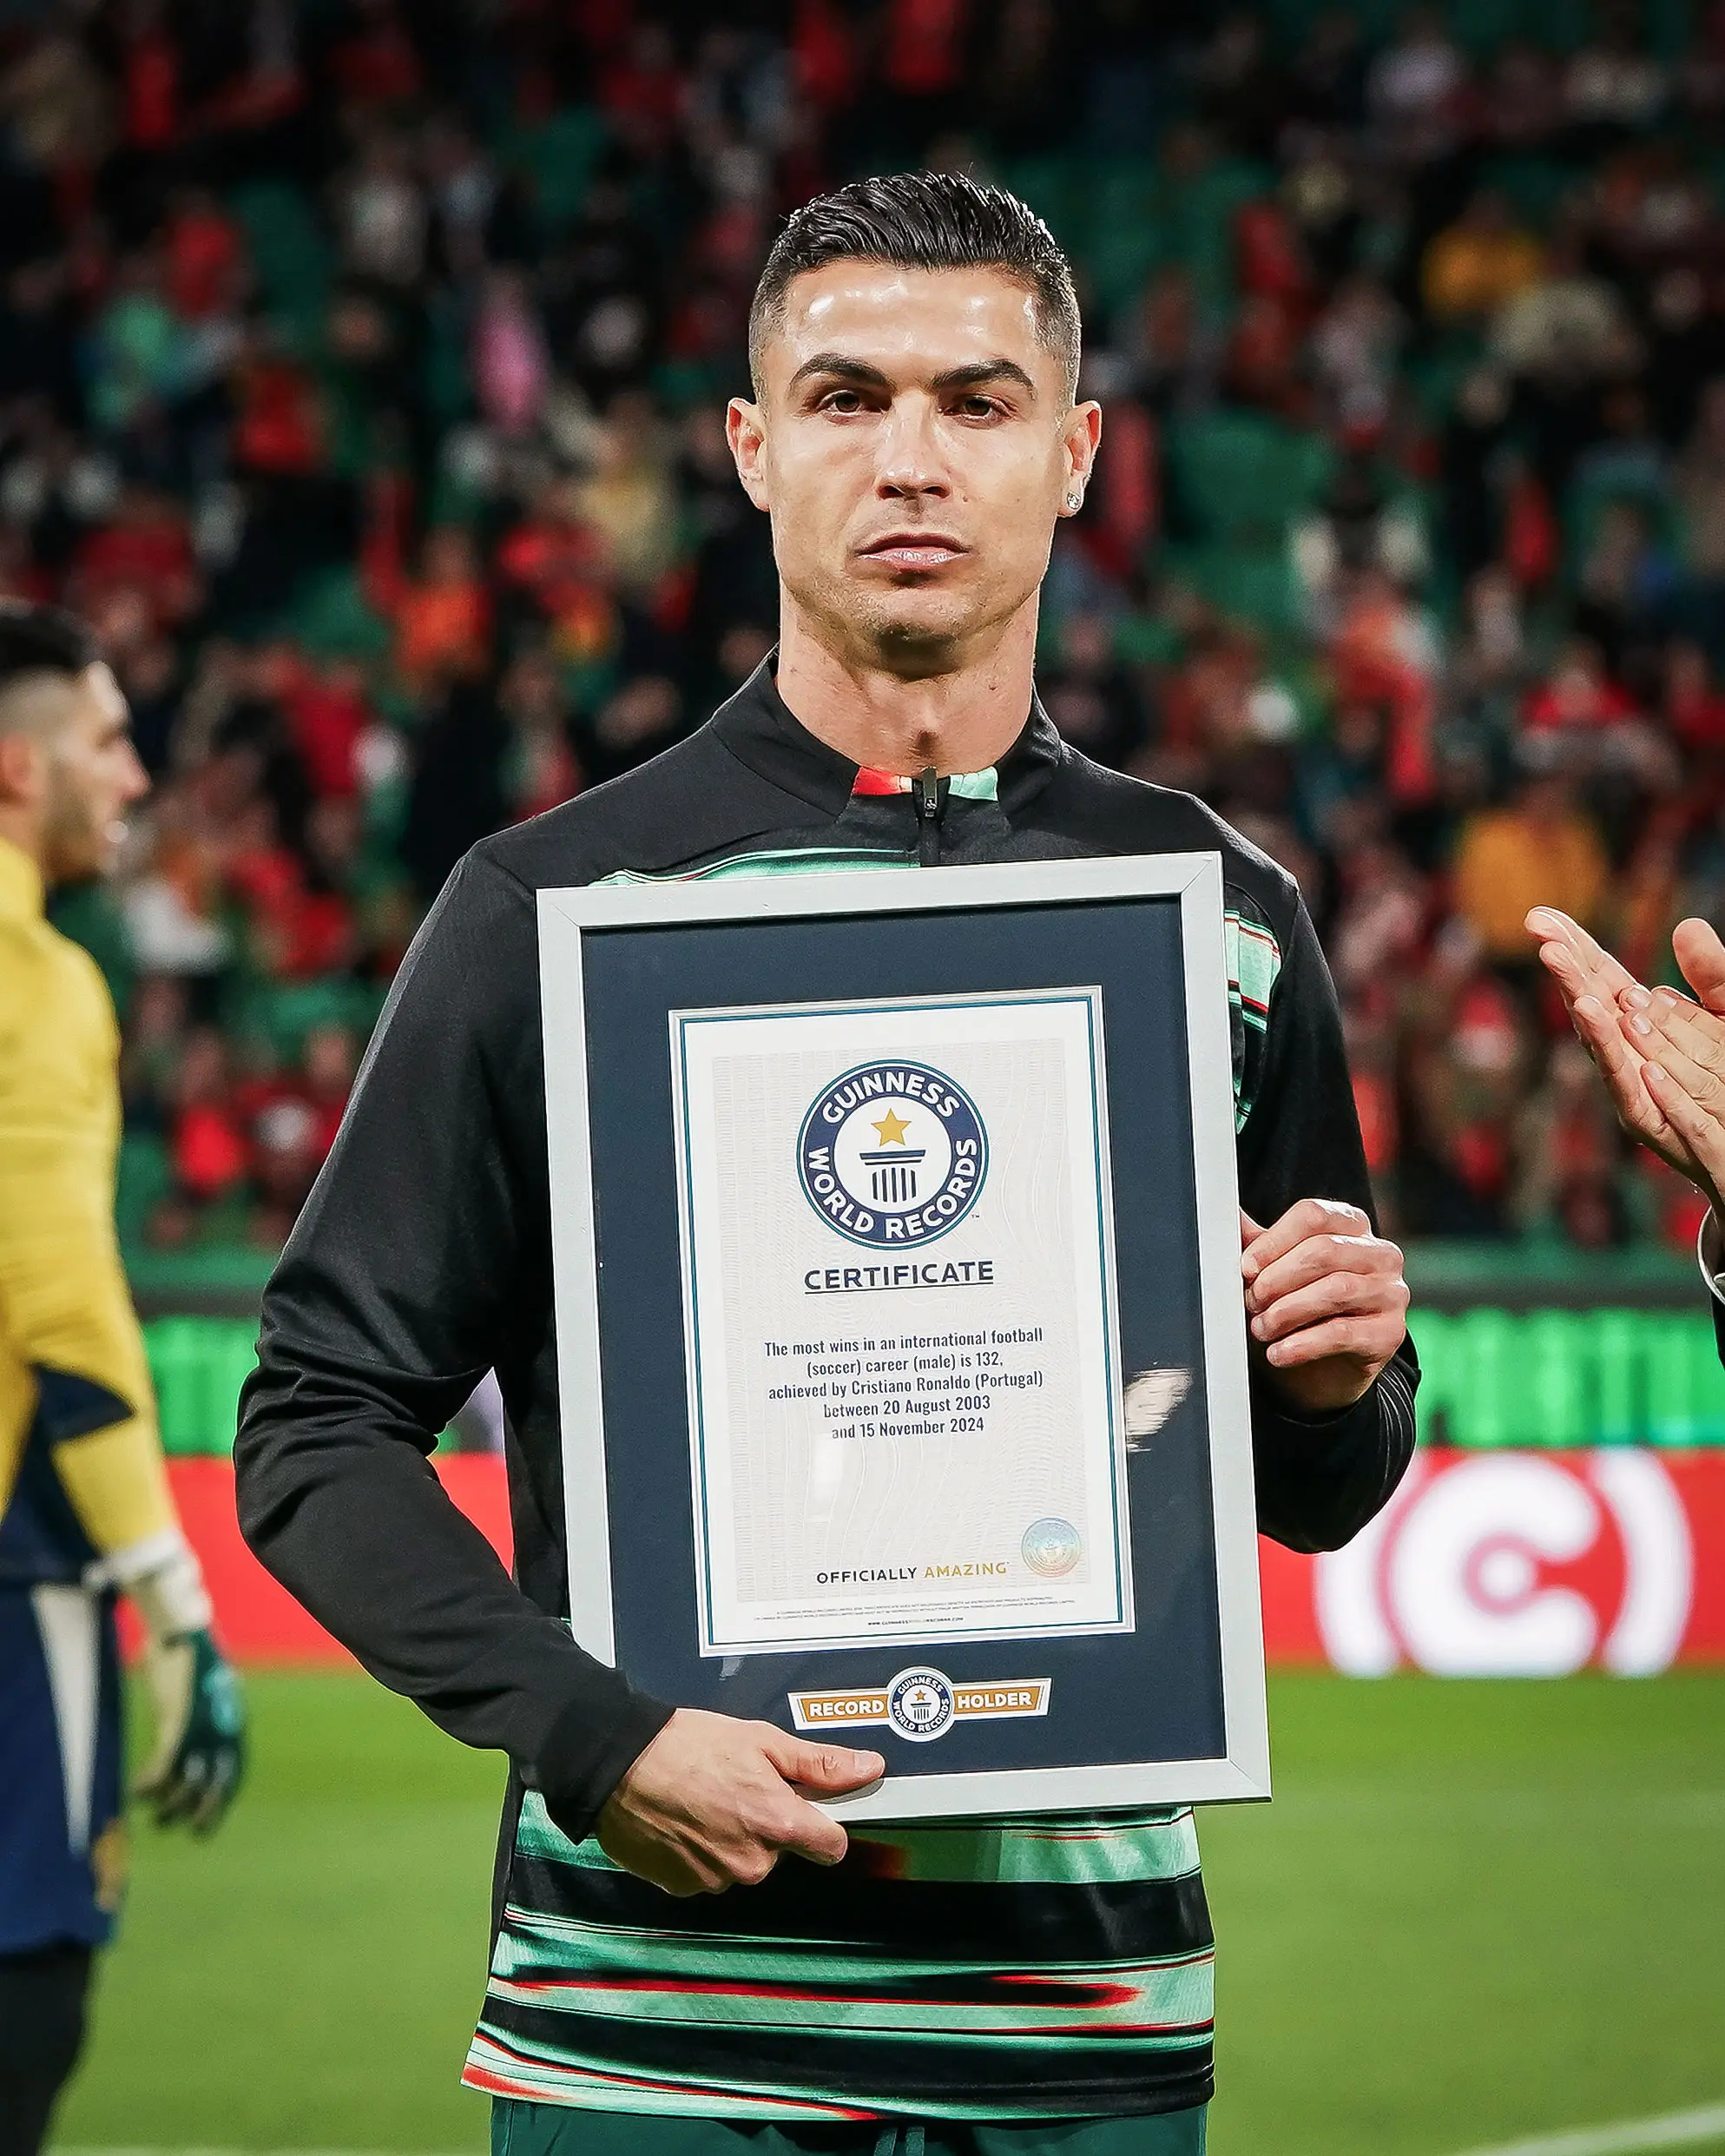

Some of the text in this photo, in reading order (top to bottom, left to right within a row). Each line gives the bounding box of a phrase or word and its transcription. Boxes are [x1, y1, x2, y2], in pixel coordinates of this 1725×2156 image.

[822, 1071, 960, 1124] GUINNESS
[808, 1138, 978, 1239] WORLD RECORDS
[804, 1261, 994, 1290] CERTIFICATE
[764, 1328, 1043, 1356] The most wins in an international football
[807, 1351, 1004, 1379] (soccer) career (male) is 132,
[768, 1370, 1044, 1399] achieved by Cristiano Ronaldo (Portugal)
[824, 1395, 991, 1418] between 20 August 2003
[832, 1417, 984, 1439] and 15 November 2024
[816, 1562, 1007, 1584] OFFICIALLY AMAZING
[897, 1676, 944, 1695] GUINNESS
[809, 1691, 1032, 1718] RECORD HOLDER
[892, 1698, 950, 1732] WORLD RECORDS
